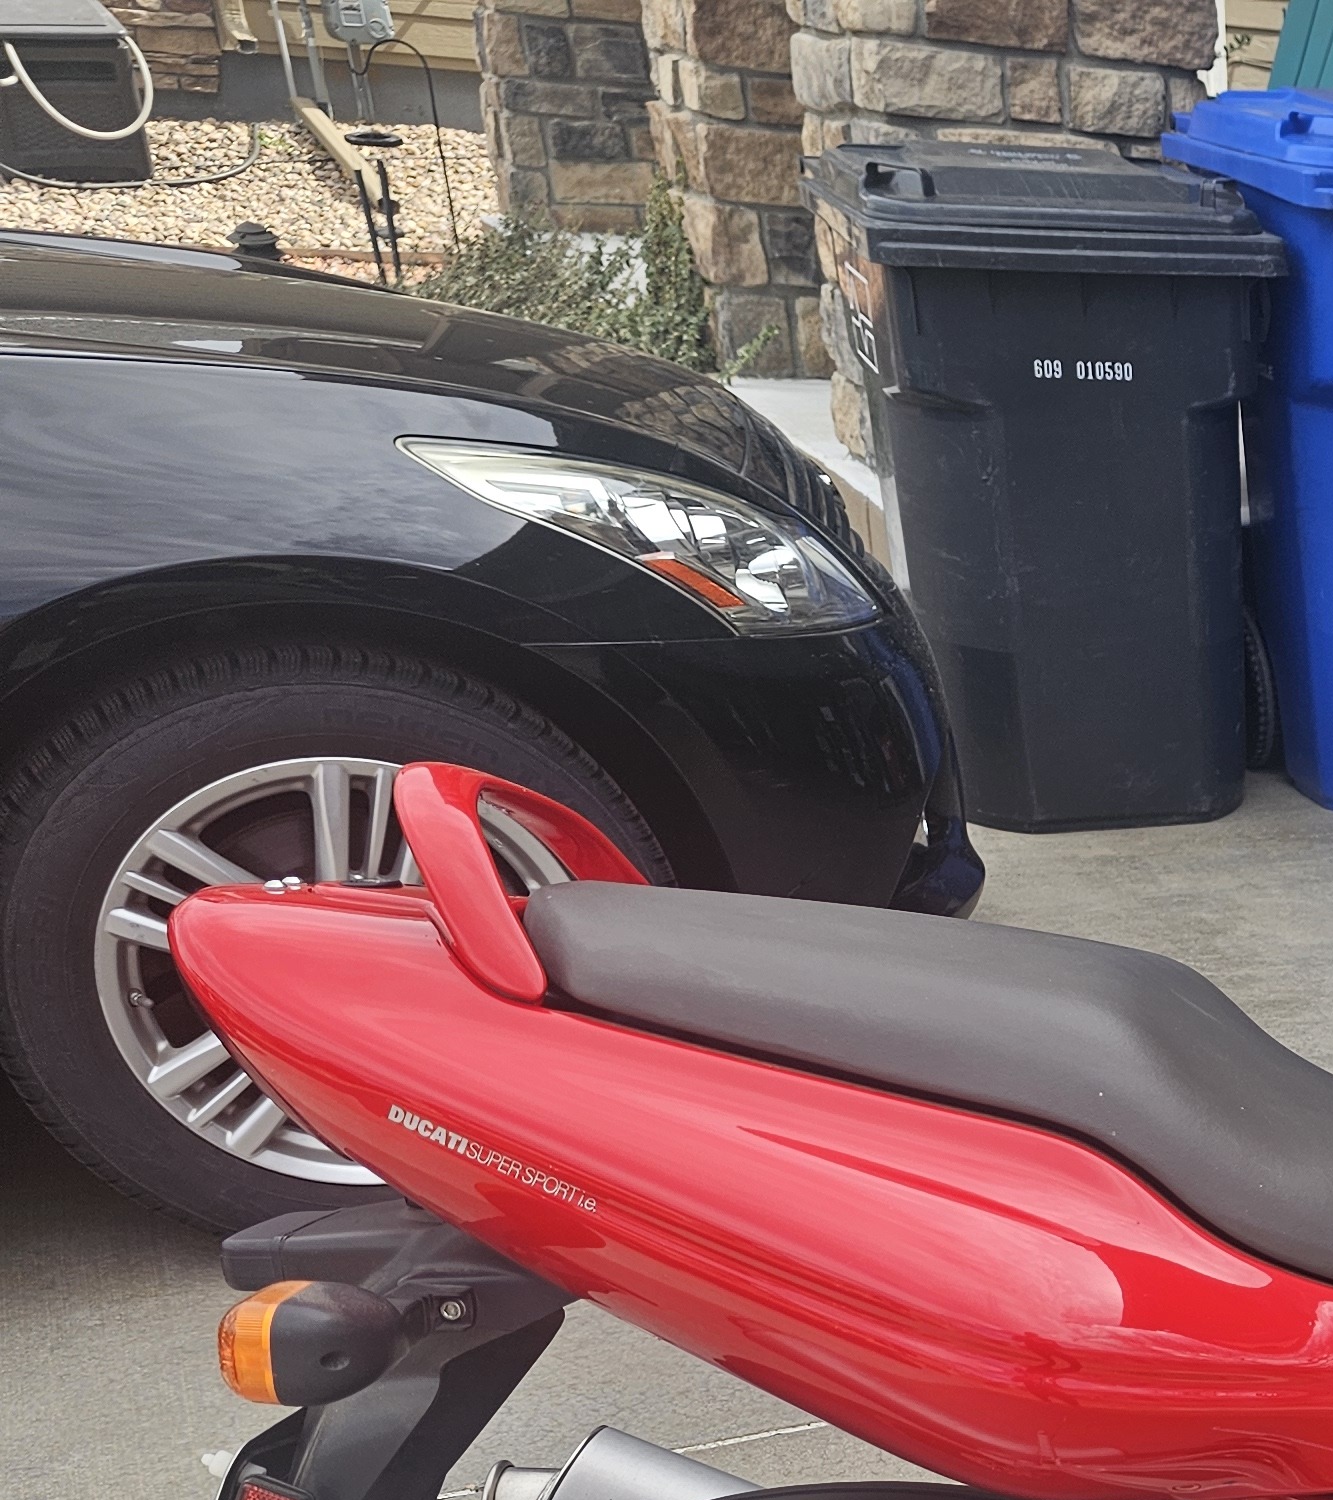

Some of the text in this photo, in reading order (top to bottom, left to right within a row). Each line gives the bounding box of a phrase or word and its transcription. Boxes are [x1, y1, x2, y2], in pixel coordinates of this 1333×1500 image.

[1033, 358, 1133, 381] 609 010590
[387, 1104, 469, 1155] DUCATI
[577, 1190, 597, 1213] i.e.
